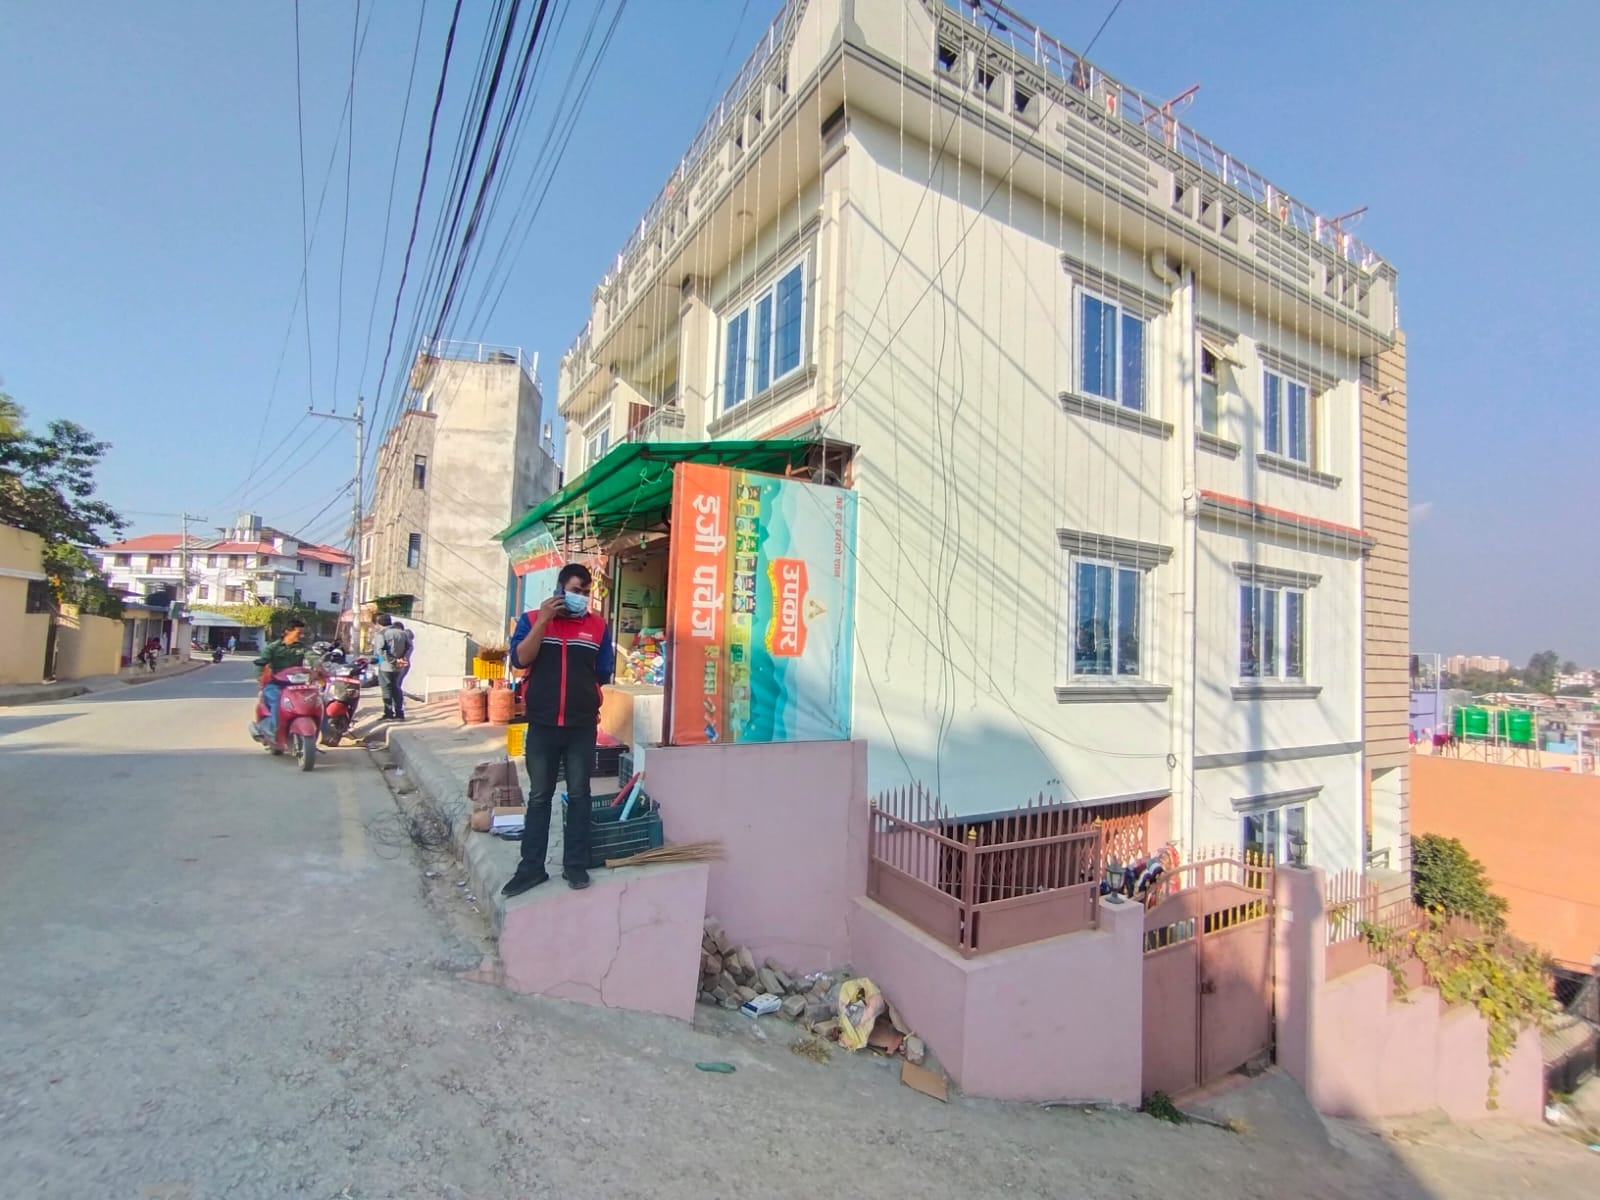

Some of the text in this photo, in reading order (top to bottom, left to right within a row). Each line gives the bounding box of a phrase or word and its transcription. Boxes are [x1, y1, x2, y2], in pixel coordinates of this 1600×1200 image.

[691, 494, 726, 640] इजी पर्चेज
[780, 564, 800, 652] उपकार
